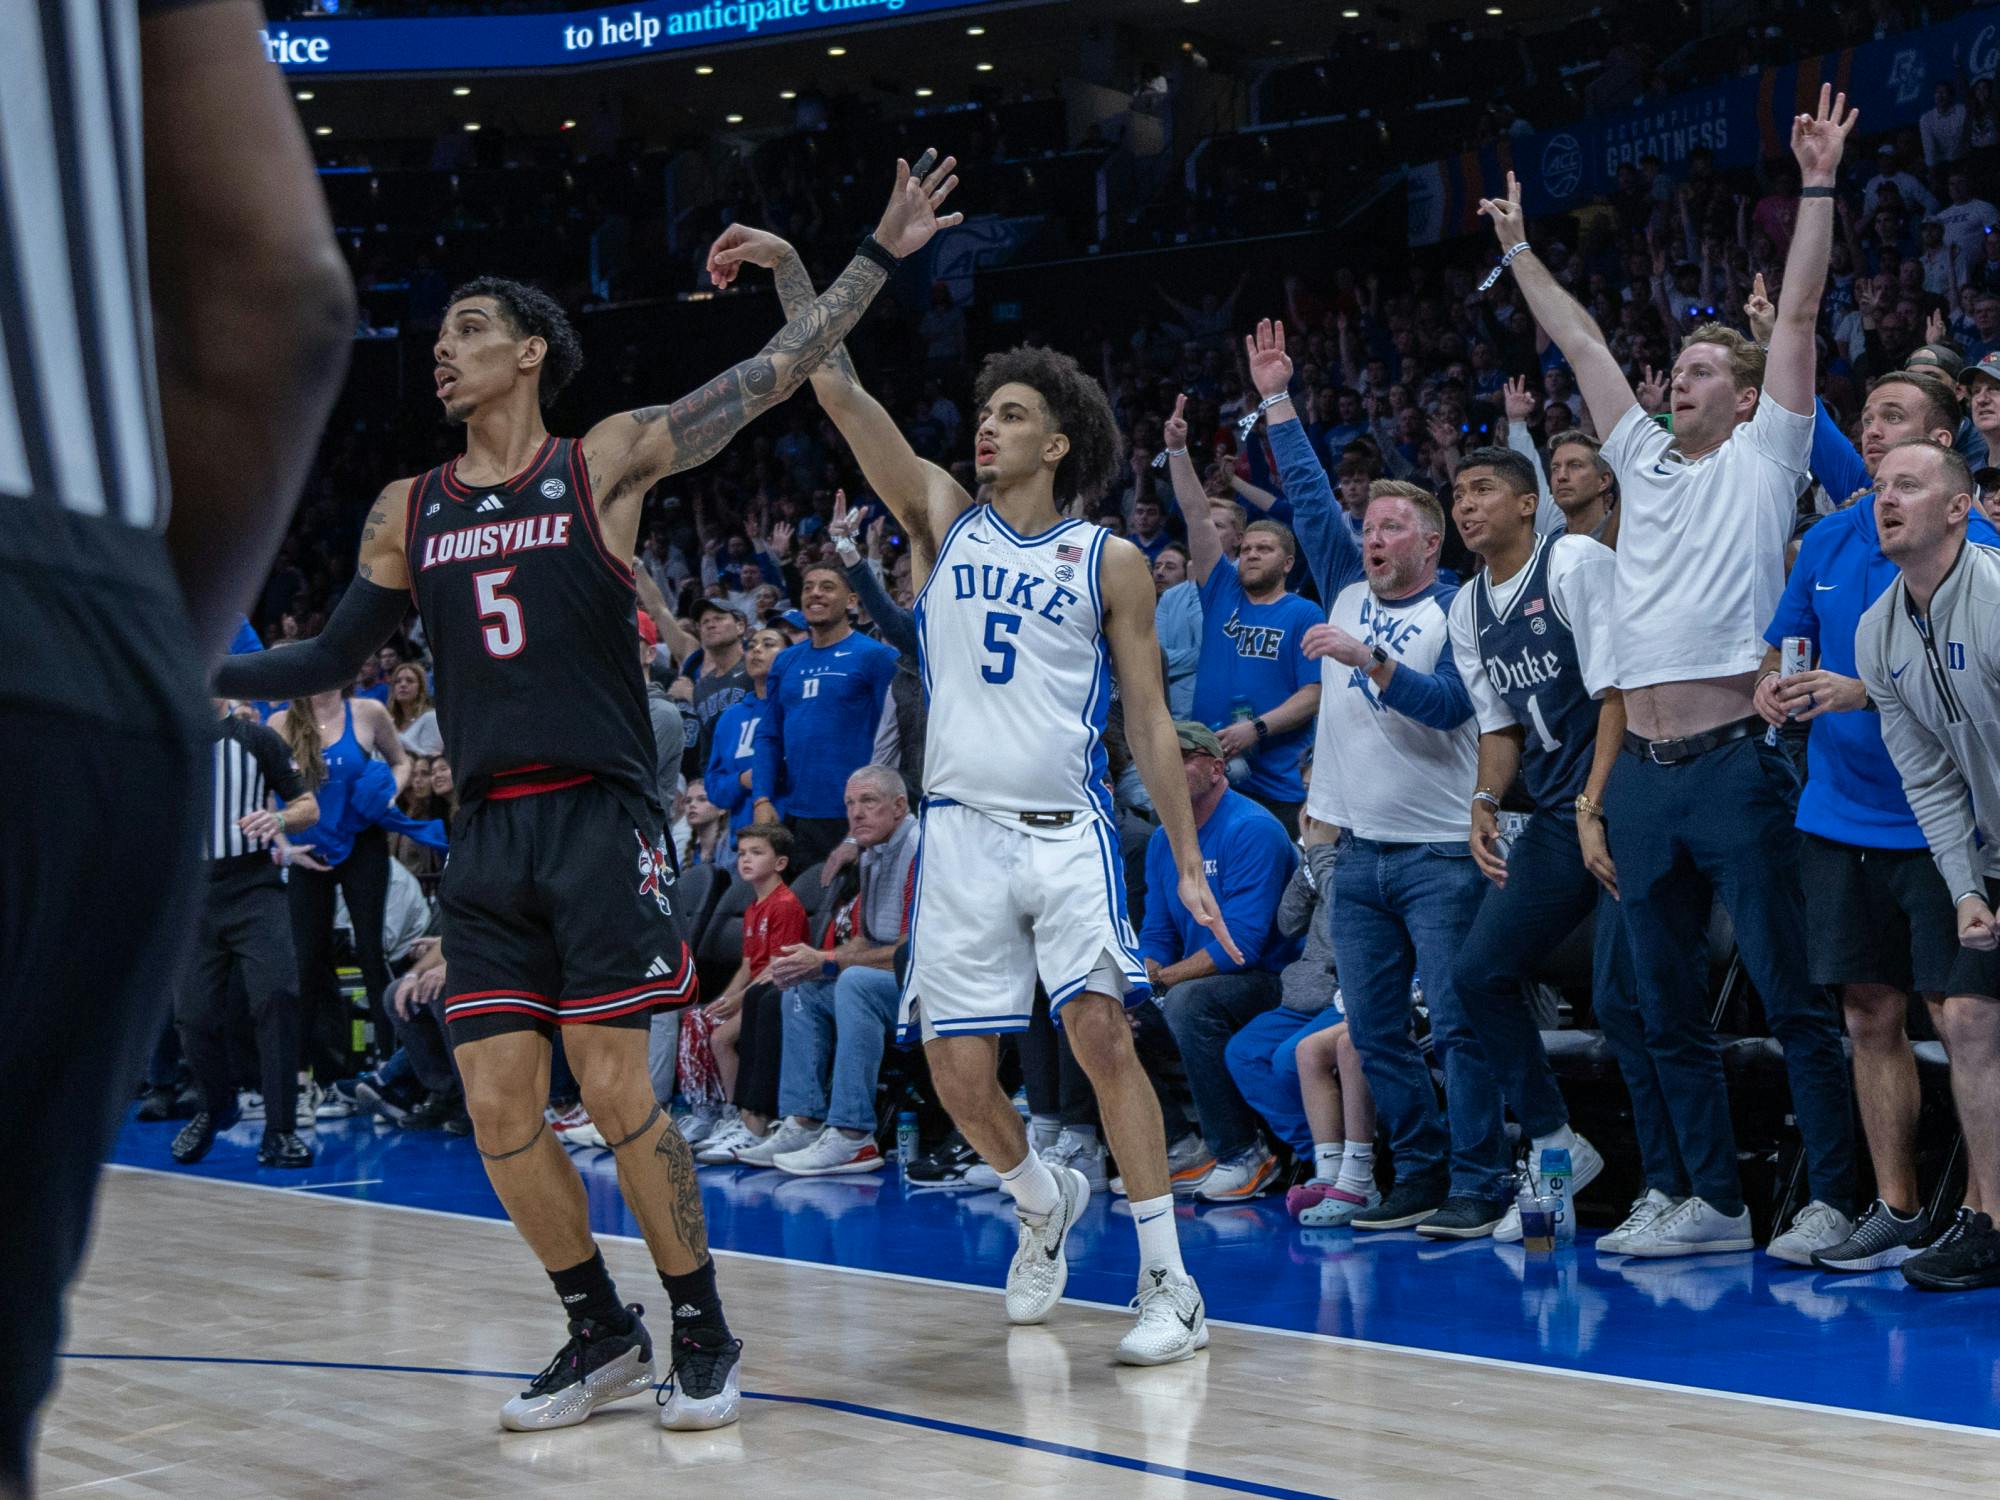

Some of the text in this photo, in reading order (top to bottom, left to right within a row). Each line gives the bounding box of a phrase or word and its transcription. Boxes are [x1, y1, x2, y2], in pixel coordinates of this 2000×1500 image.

[565, 24, 593, 50] to
[601, 12, 660, 47] help
[667, 0, 809, 35] anticipate
[1606, 117, 1728, 178] GREATNESS
[426, 502, 441, 516] JB
[421, 513, 573, 571] LOUISVILLE
[472, 565, 527, 660] 5
[951, 563, 1079, 626] DUKE
[981, 611, 1023, 685] 5
[1222, 607, 1286, 661] KE
[1360, 597, 1422, 655] DUKE
[1486, 646, 1563, 696] Duke
[1526, 694, 1563, 753] 1
